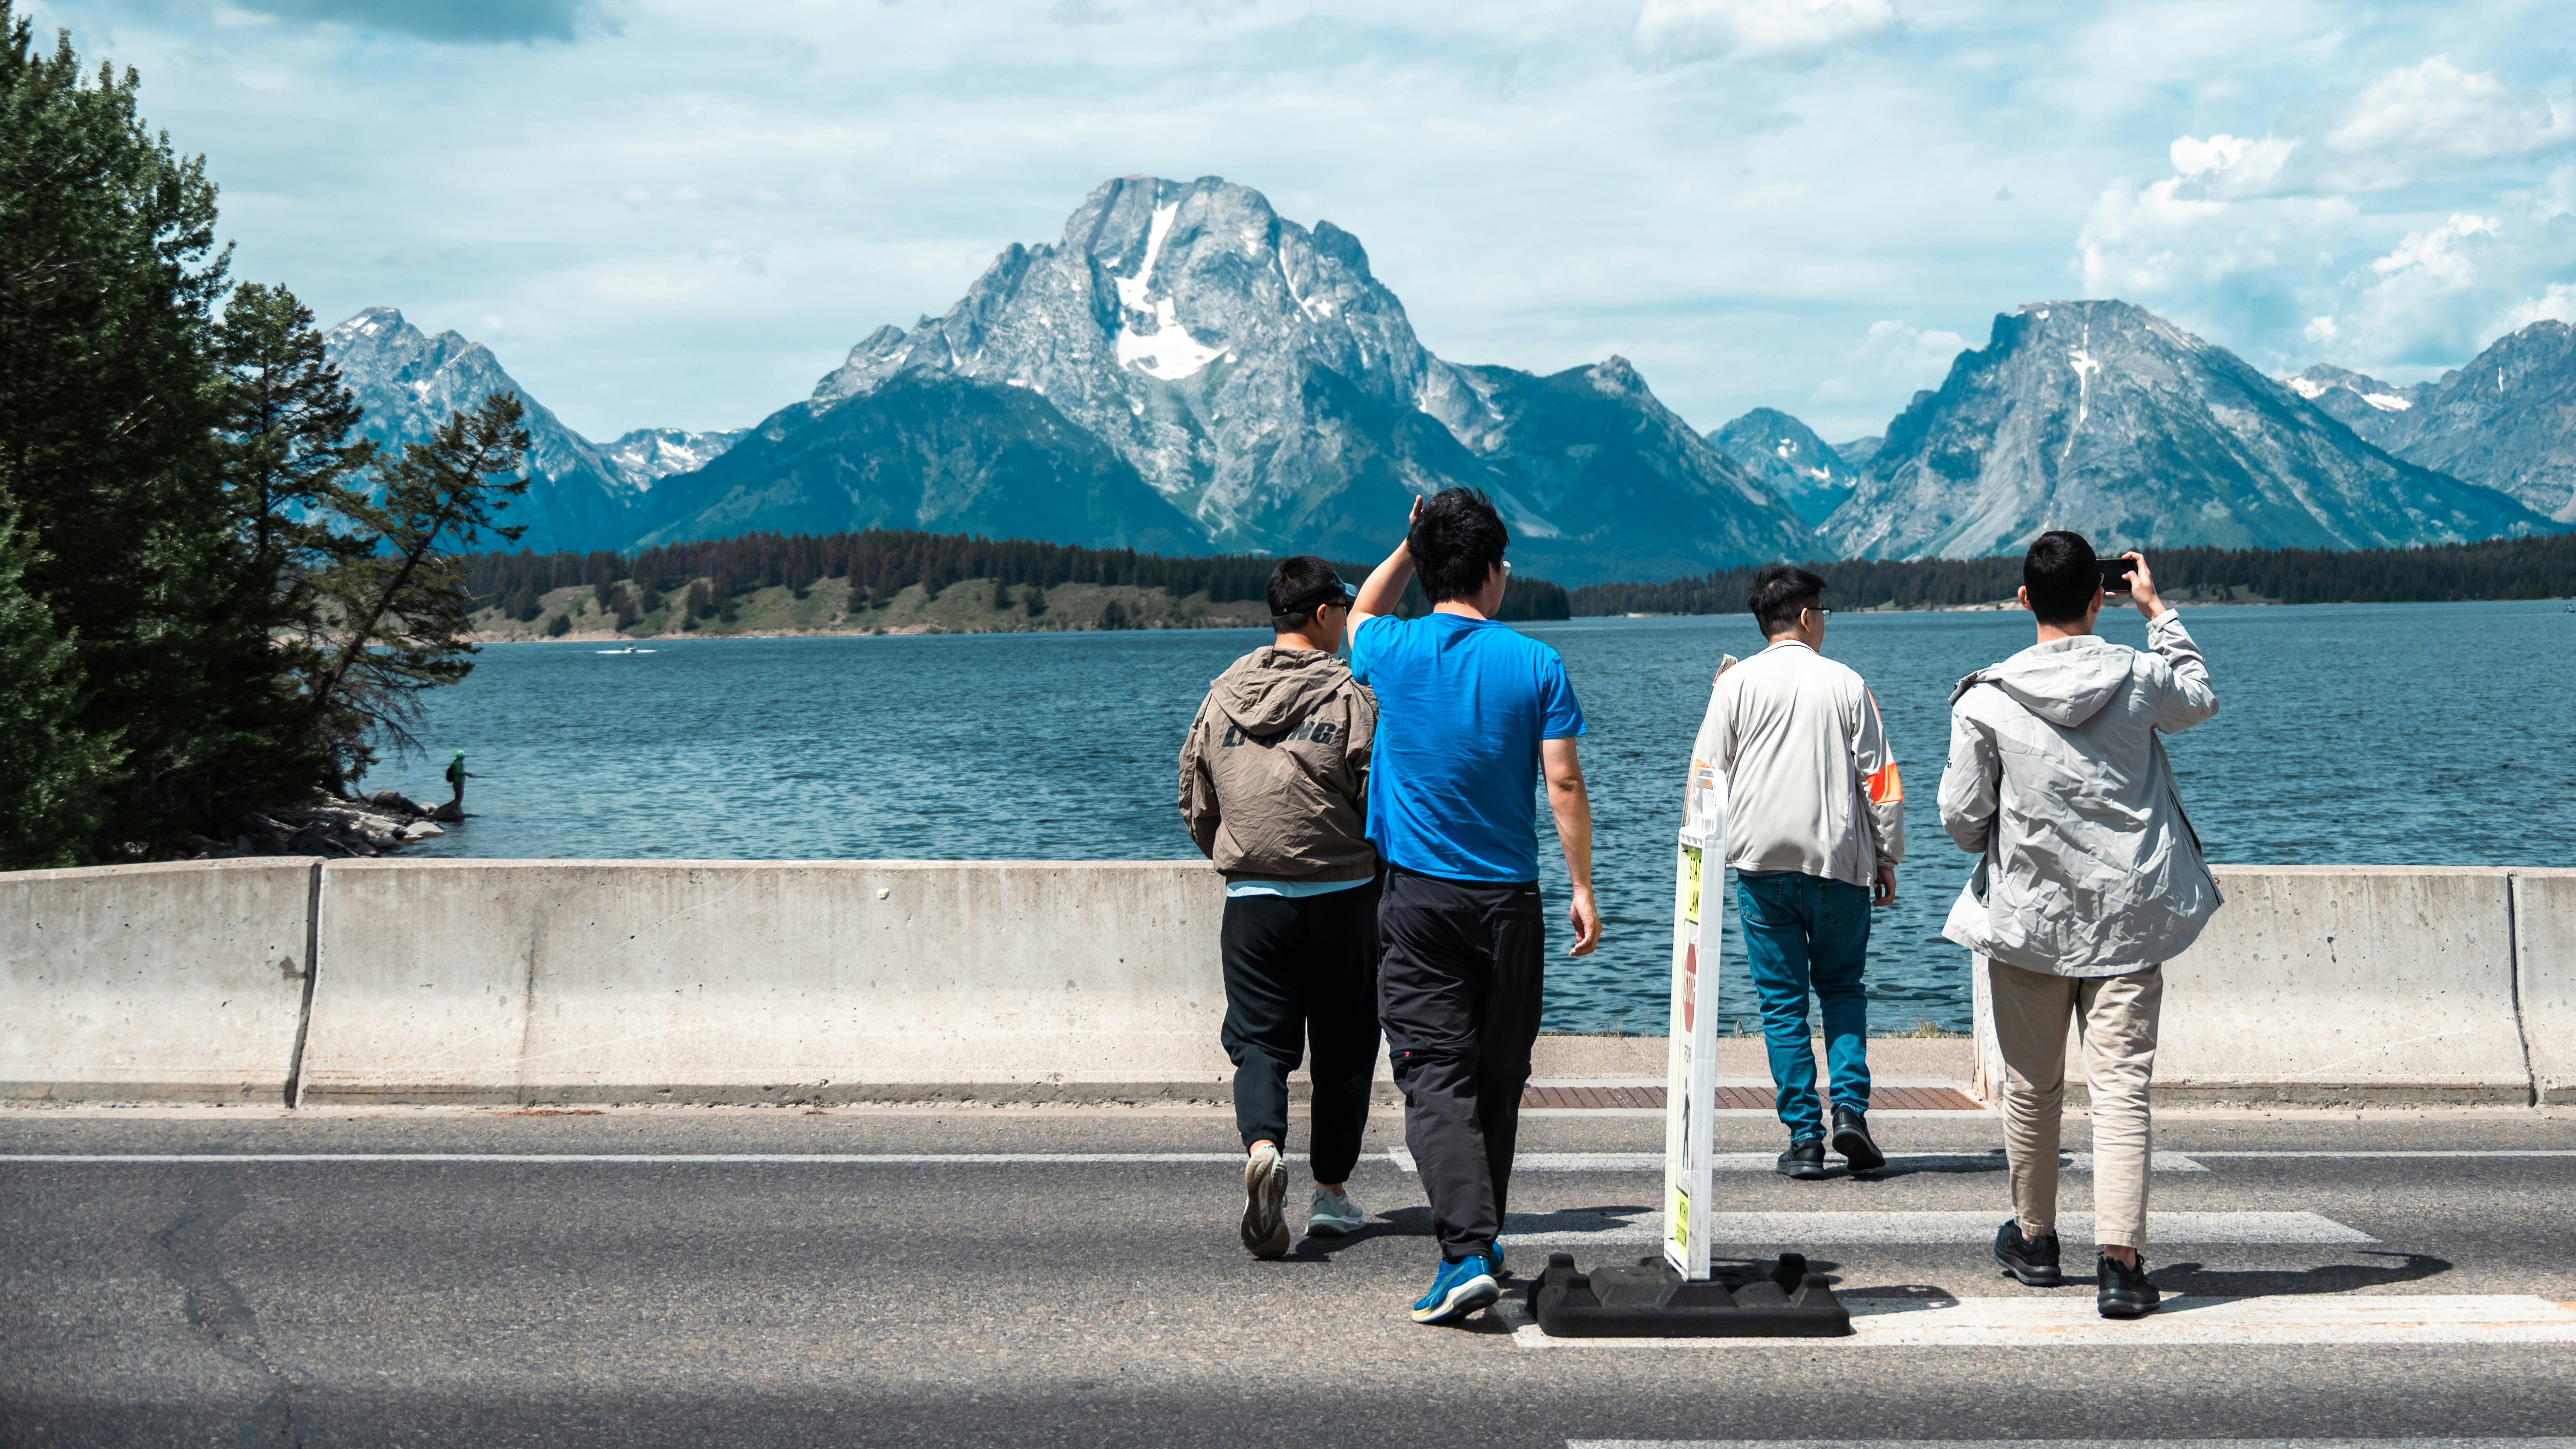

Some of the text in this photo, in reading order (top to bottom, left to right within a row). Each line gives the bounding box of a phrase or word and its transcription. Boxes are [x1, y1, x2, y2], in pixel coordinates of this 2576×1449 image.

[1689, 856, 1701, 882] STAT
[1689, 888, 1700, 914] LAW
[1675, 1222, 1687, 1249] CROSSW
